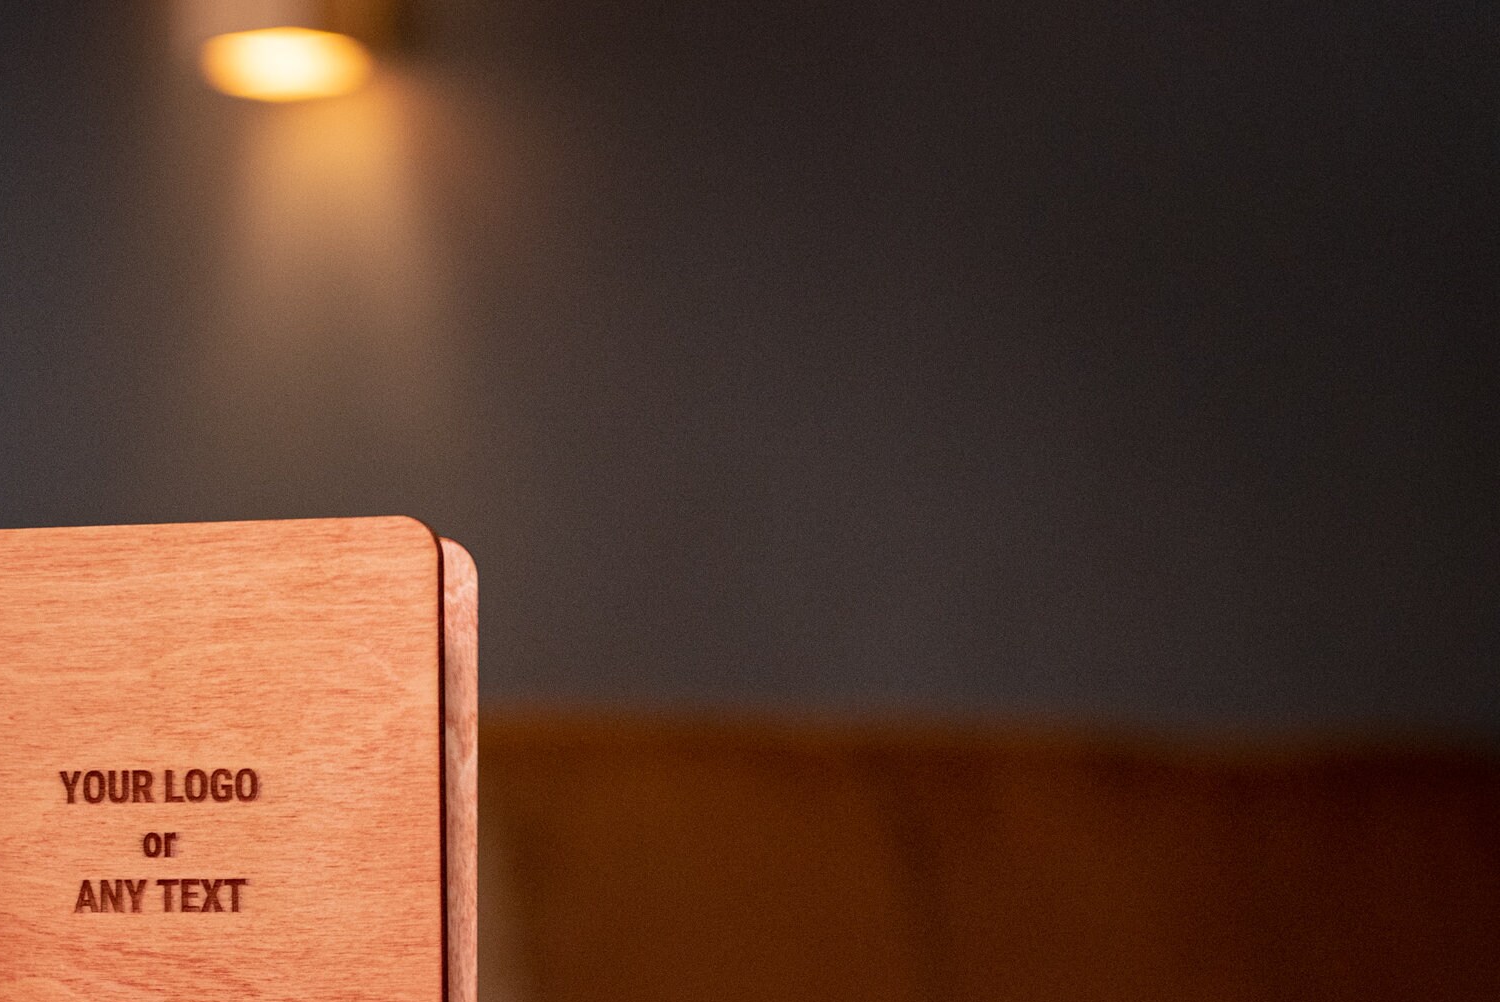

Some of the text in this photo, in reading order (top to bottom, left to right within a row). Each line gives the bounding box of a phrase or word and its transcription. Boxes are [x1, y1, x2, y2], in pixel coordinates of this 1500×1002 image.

[59, 768, 260, 804] YOUR LOGO
[142, 832, 177, 858] or
[74, 878, 248, 913] ANY TEXT
